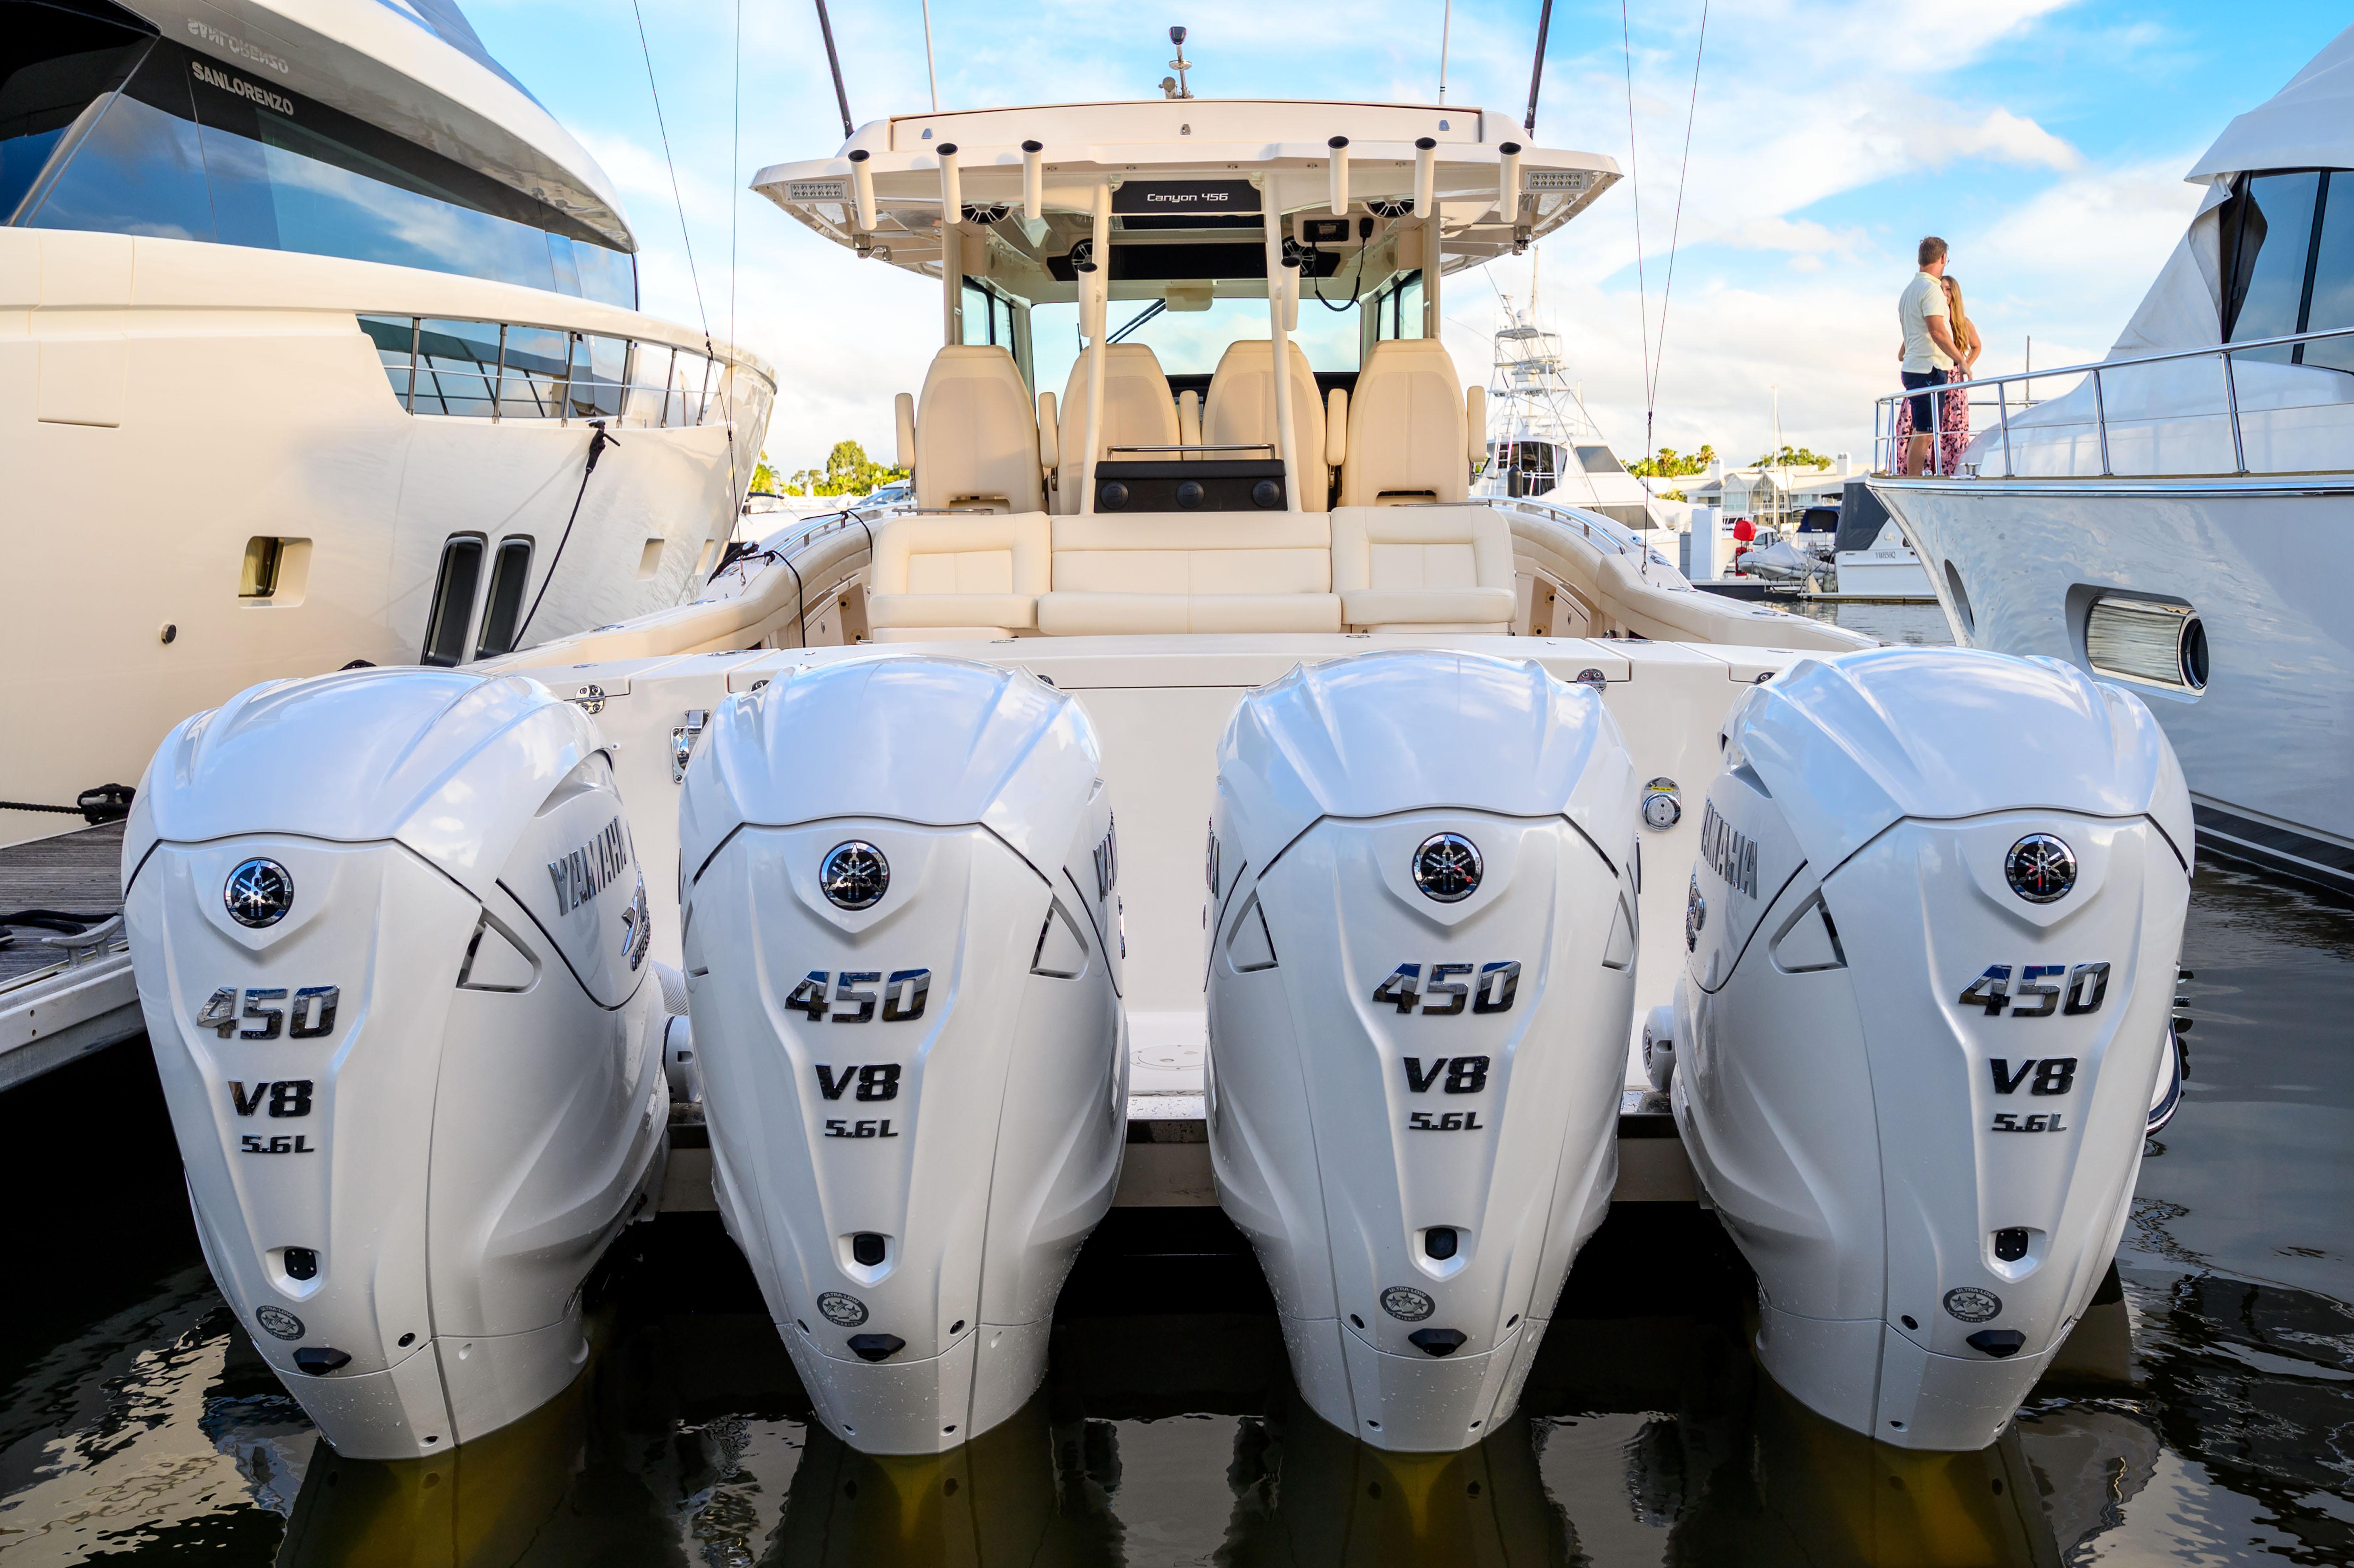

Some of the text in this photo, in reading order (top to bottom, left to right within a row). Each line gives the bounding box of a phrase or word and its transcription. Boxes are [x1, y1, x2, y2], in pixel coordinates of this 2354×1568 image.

[192, 61, 294, 116] SANLORENZO
[1147, 193, 1229, 203] Canyon 456
[548, 815, 628, 916] YAMAHA
[784, 968, 932, 1023] 450
[1372, 960, 1521, 1015] 450
[1959, 961, 2111, 1016] 450
[197, 984, 340, 1039] 450
[815, 1063, 901, 1101] V8
[1403, 1055, 1490, 1093] V8
[1990, 1056, 2078, 1096] V8
[227, 1079, 314, 1118] V8
[824, 1119, 898, 1138] 5.6L
[1409, 1111, 1483, 1130] 5.6L
[1992, 1113, 2067, 1132] 5.6L
[241, 1135, 315, 1153] 5.6L
